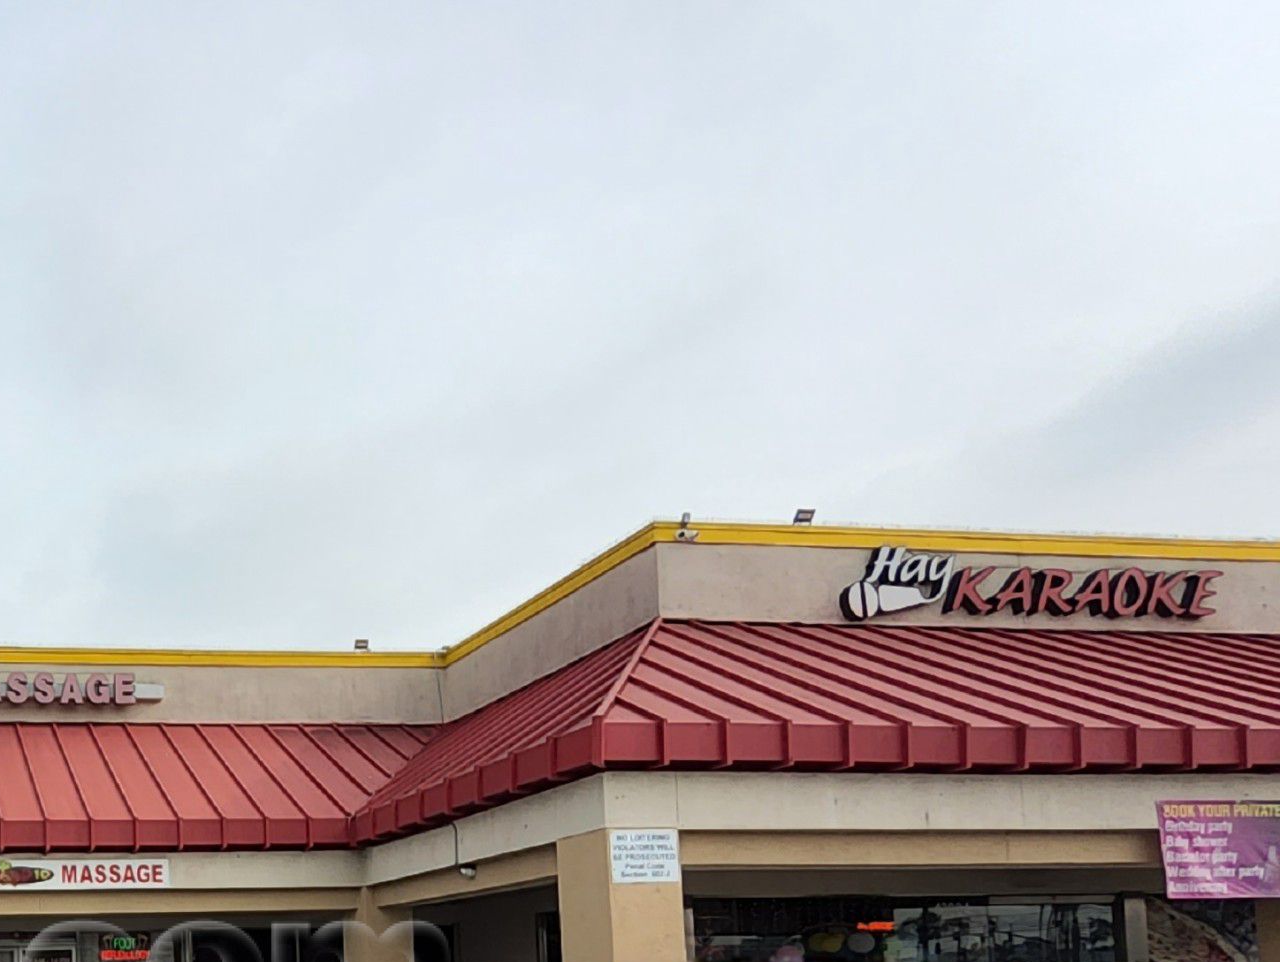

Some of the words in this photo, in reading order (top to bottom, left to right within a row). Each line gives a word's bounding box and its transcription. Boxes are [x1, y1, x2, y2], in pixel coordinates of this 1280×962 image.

[867, 546, 955, 600] Hay
[948, 566, 1223, 616] KARAOKE
[1198, 804, 1231, 817] YOUR
[61, 864, 164, 883] MASSAGE
